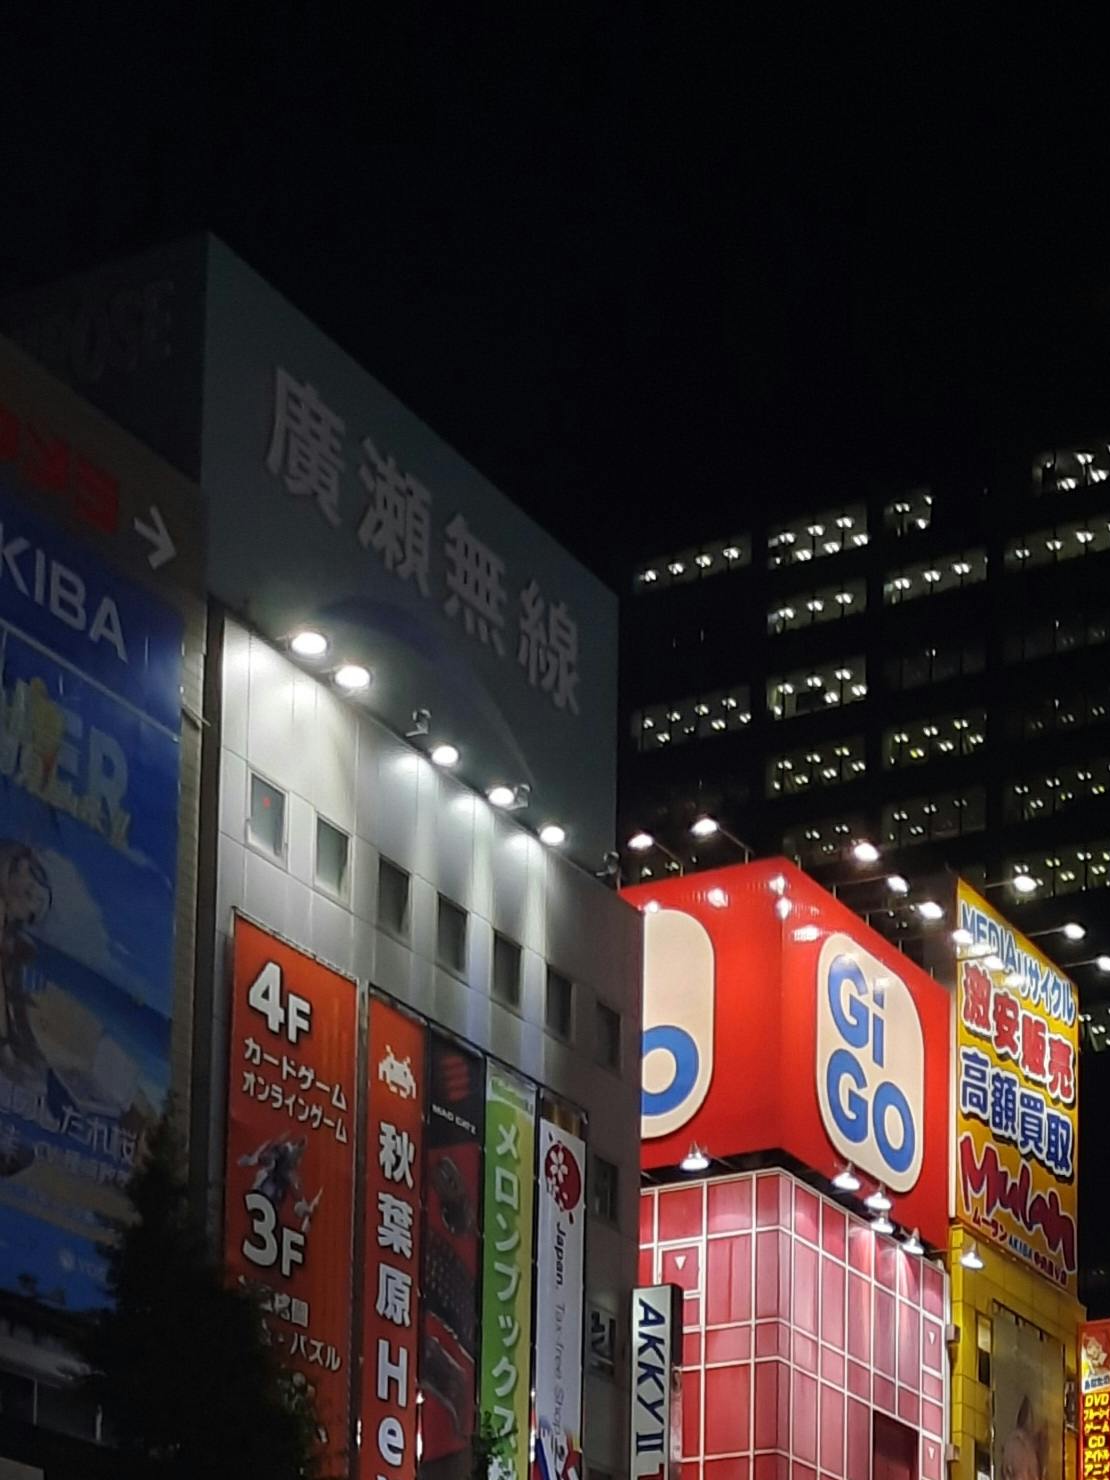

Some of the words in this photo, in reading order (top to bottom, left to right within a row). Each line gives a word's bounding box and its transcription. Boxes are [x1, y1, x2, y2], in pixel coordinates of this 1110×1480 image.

[248, 960, 312, 1044] 4F
[962, 960, 1075, 1101] 激安販売
[242, 1070, 349, 1144] オンラインゲーム
[243, 1036, 349, 1111] カードゲーム
[961, 1048, 1074, 1177] 高額買取
[242, 1192, 306, 1278] 3F
[636, 1297, 666, 1426] AKKY
[1083, 1423, 1110, 1436] ゲーム
[1084, 1393, 1110, 1408] DVD
[1084, 1463, 1110, 1476] アニメ
[1087, 1434, 1107, 1449] CD
